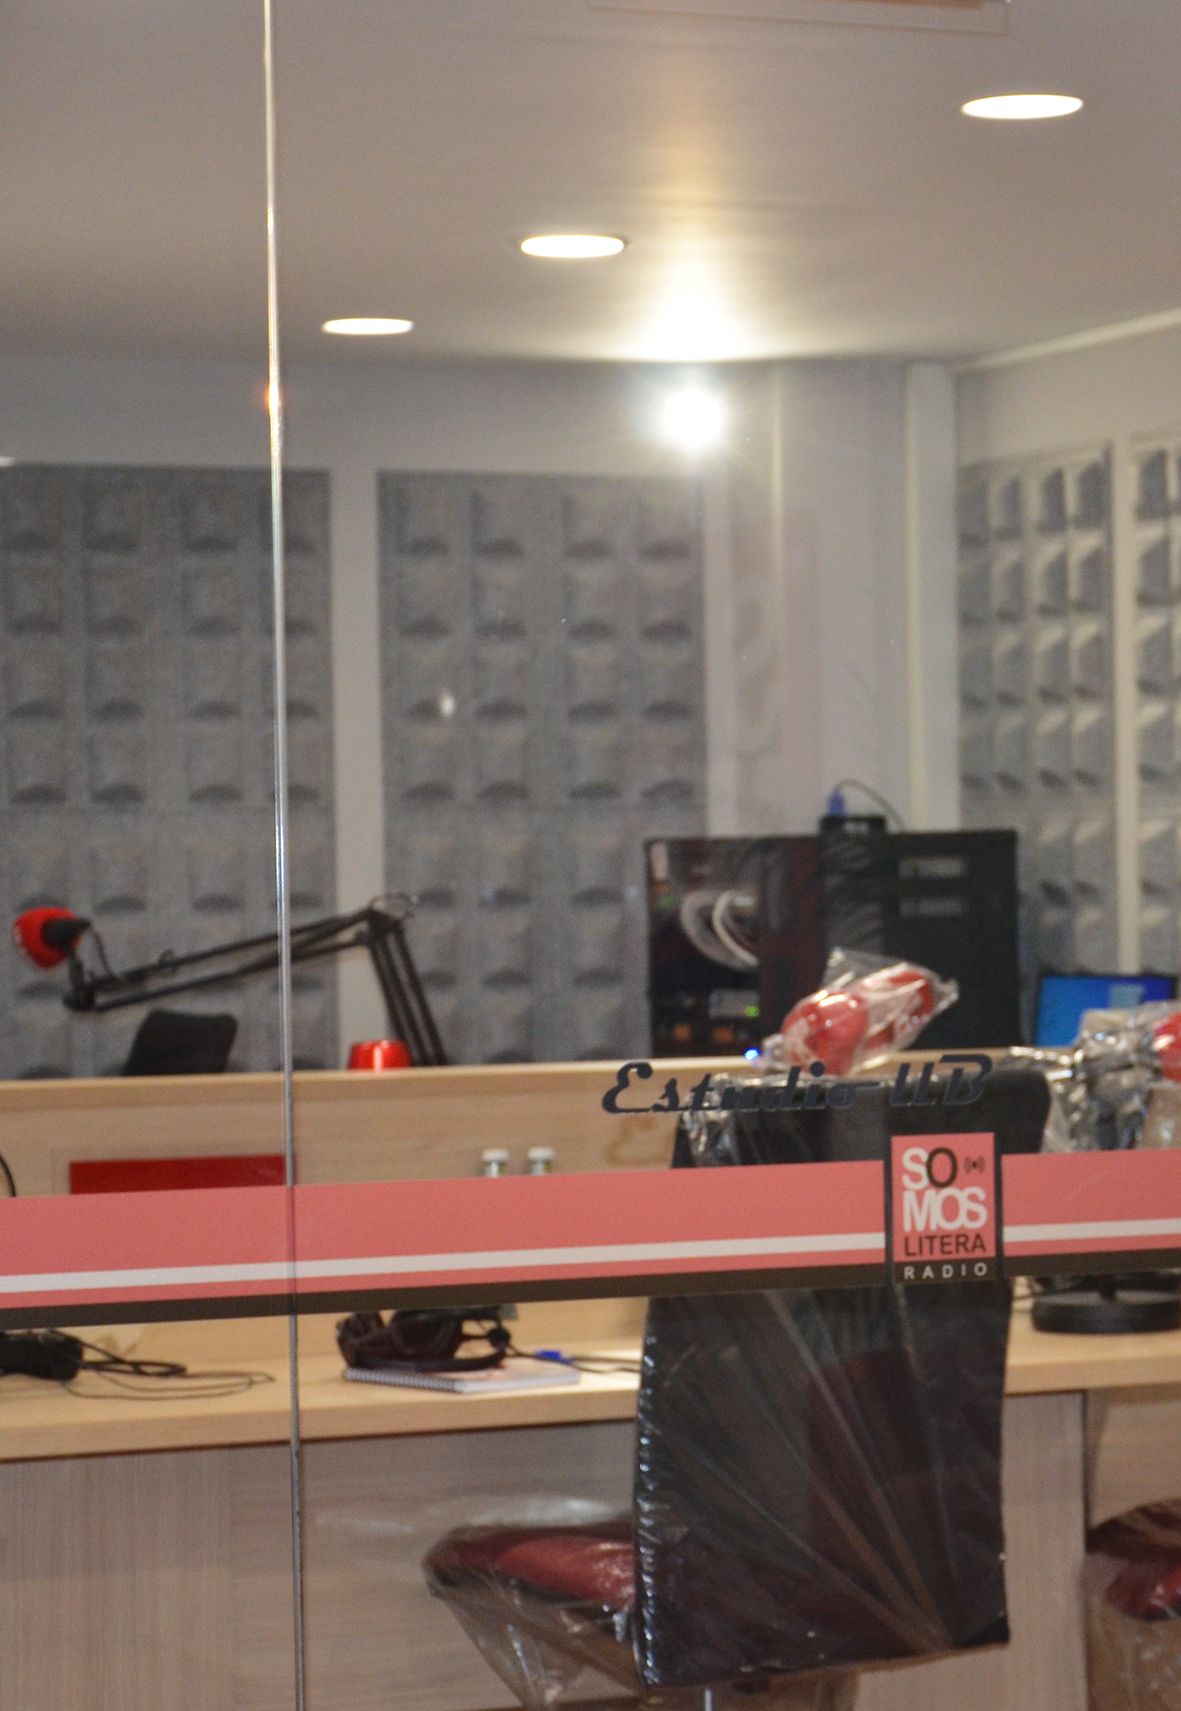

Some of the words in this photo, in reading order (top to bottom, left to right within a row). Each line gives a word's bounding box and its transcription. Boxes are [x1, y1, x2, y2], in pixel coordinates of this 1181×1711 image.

[602, 1061, 882, 1114] Estudio
[902, 1147, 958, 1189] SO
[903, 1186, 988, 1232] MOS
[904, 1234, 986, 1257] LITERA
[904, 1262, 988, 1280] RADIO
